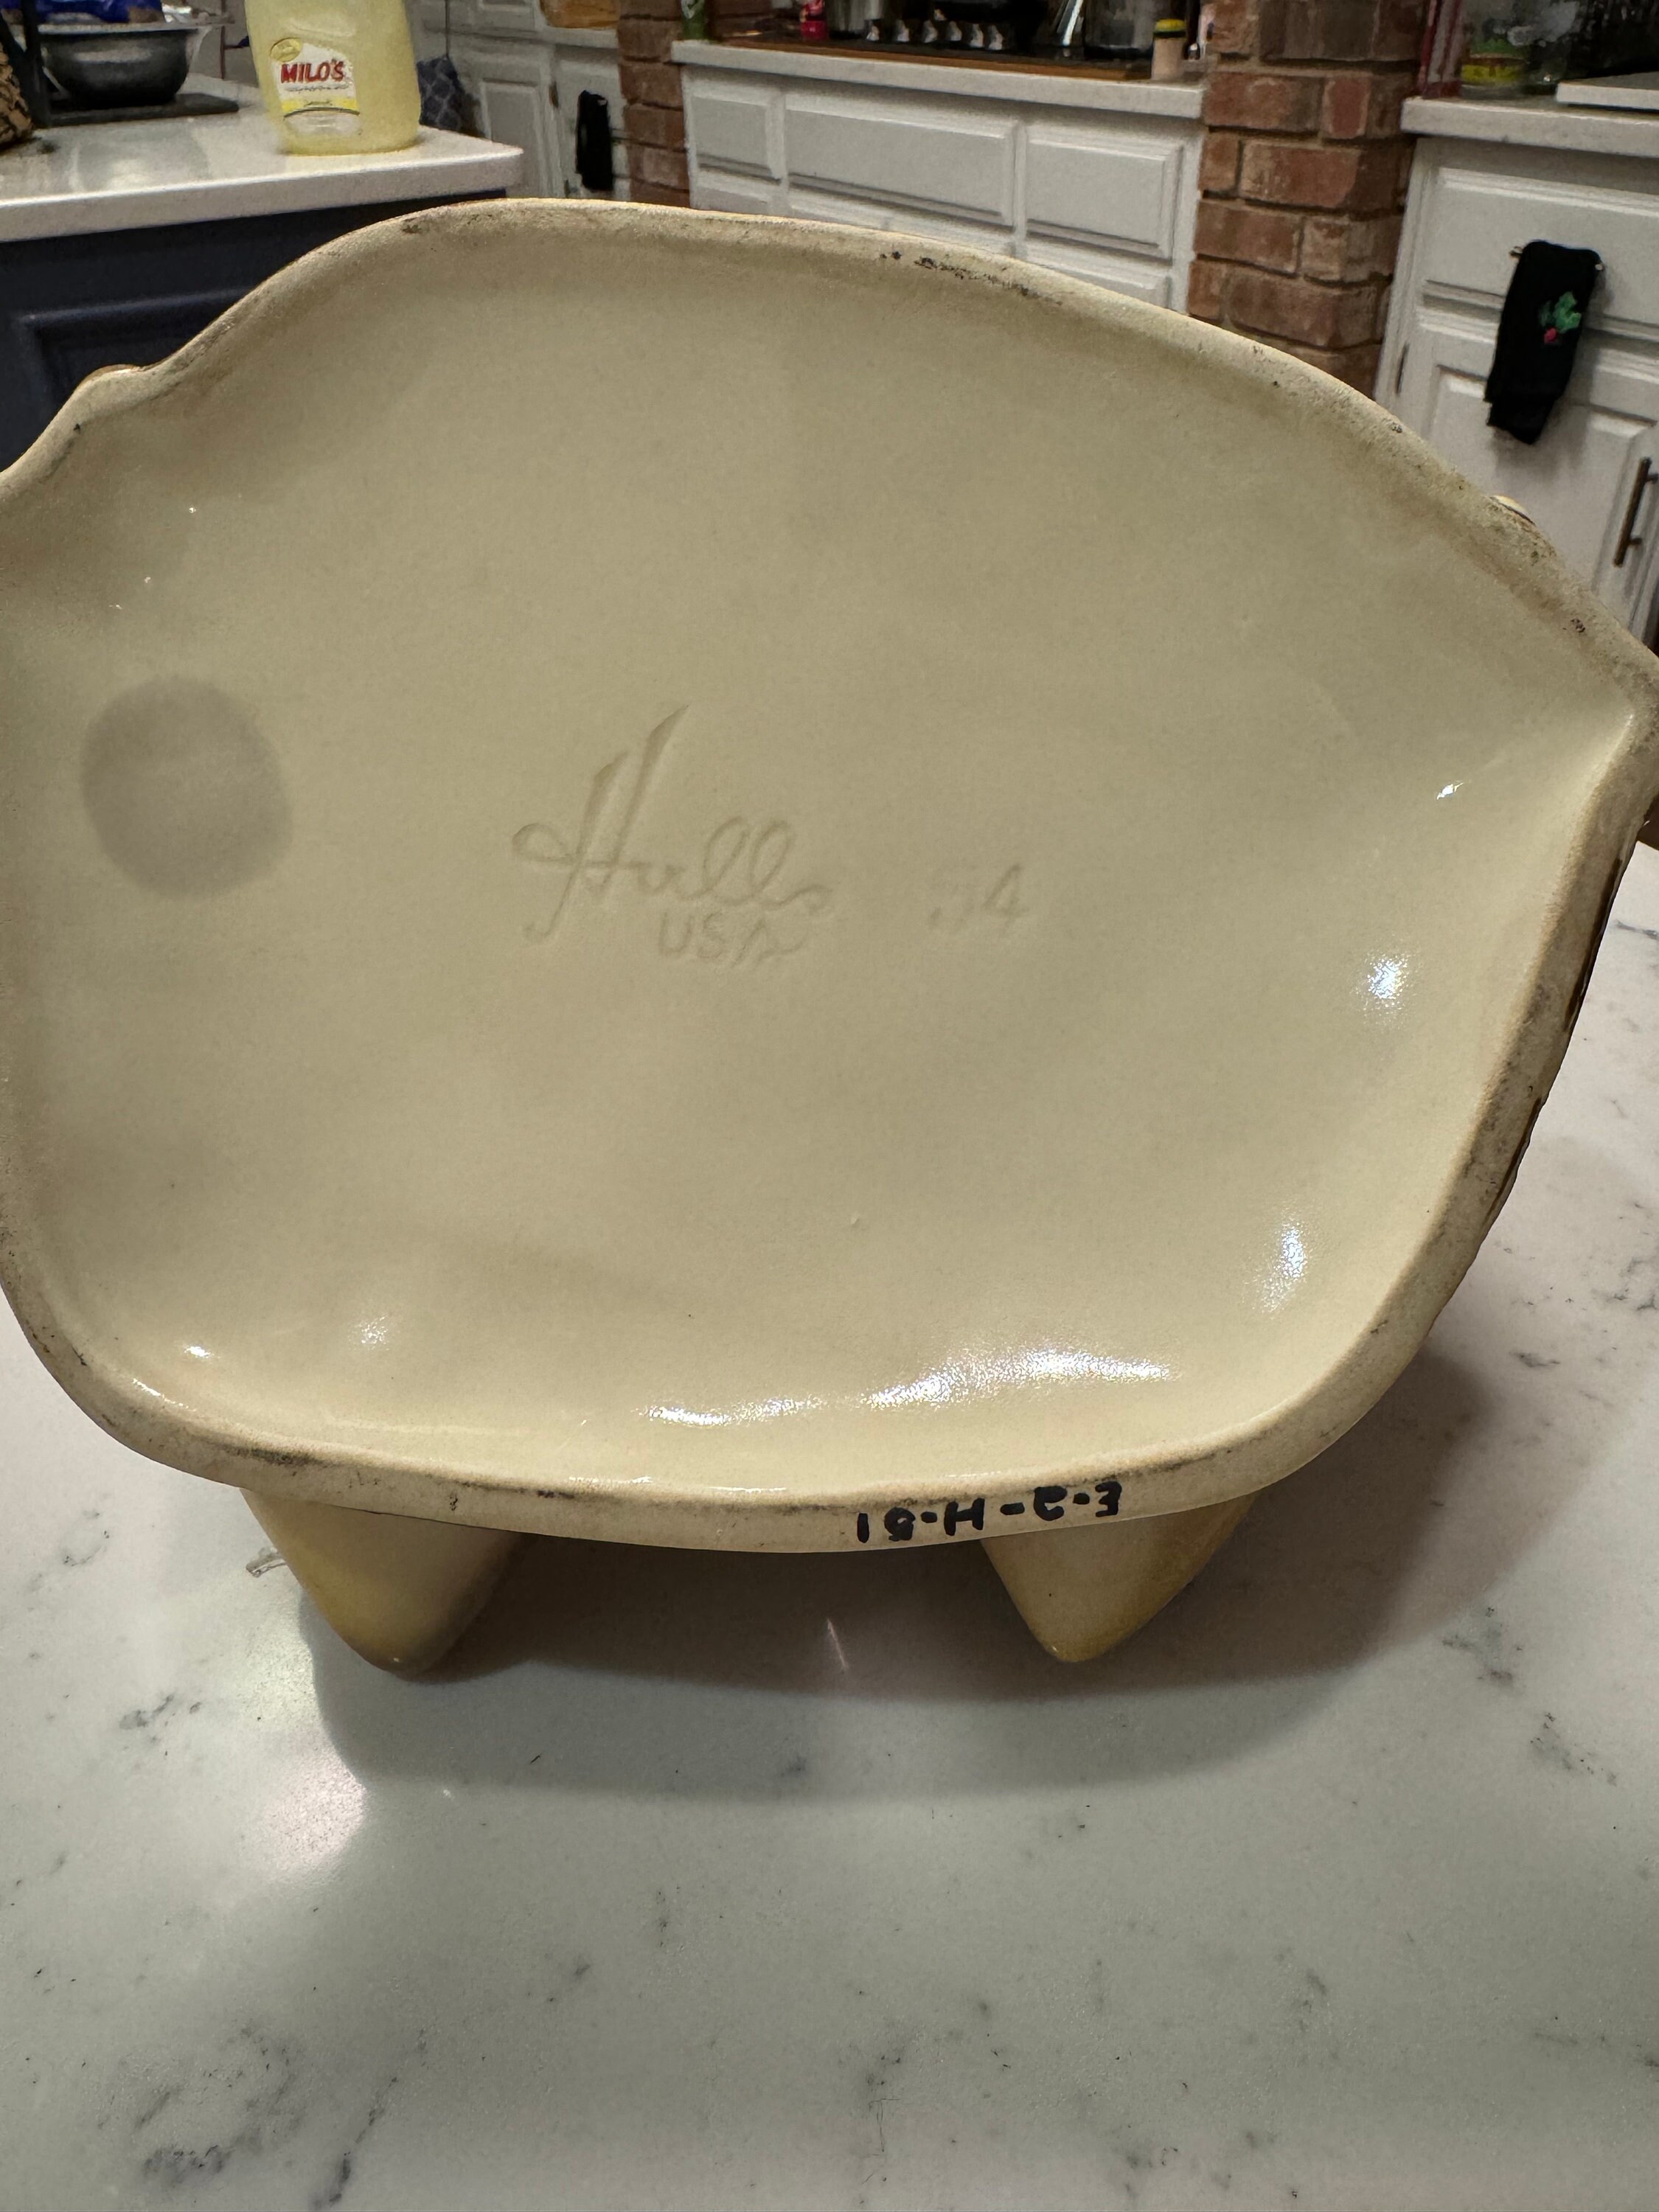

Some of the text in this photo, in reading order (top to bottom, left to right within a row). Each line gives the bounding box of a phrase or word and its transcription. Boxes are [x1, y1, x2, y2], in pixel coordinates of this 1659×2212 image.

[280, 58, 345, 83] MILO'S
[512, 704, 834, 941] Hull
[658, 908, 811, 967] USA
